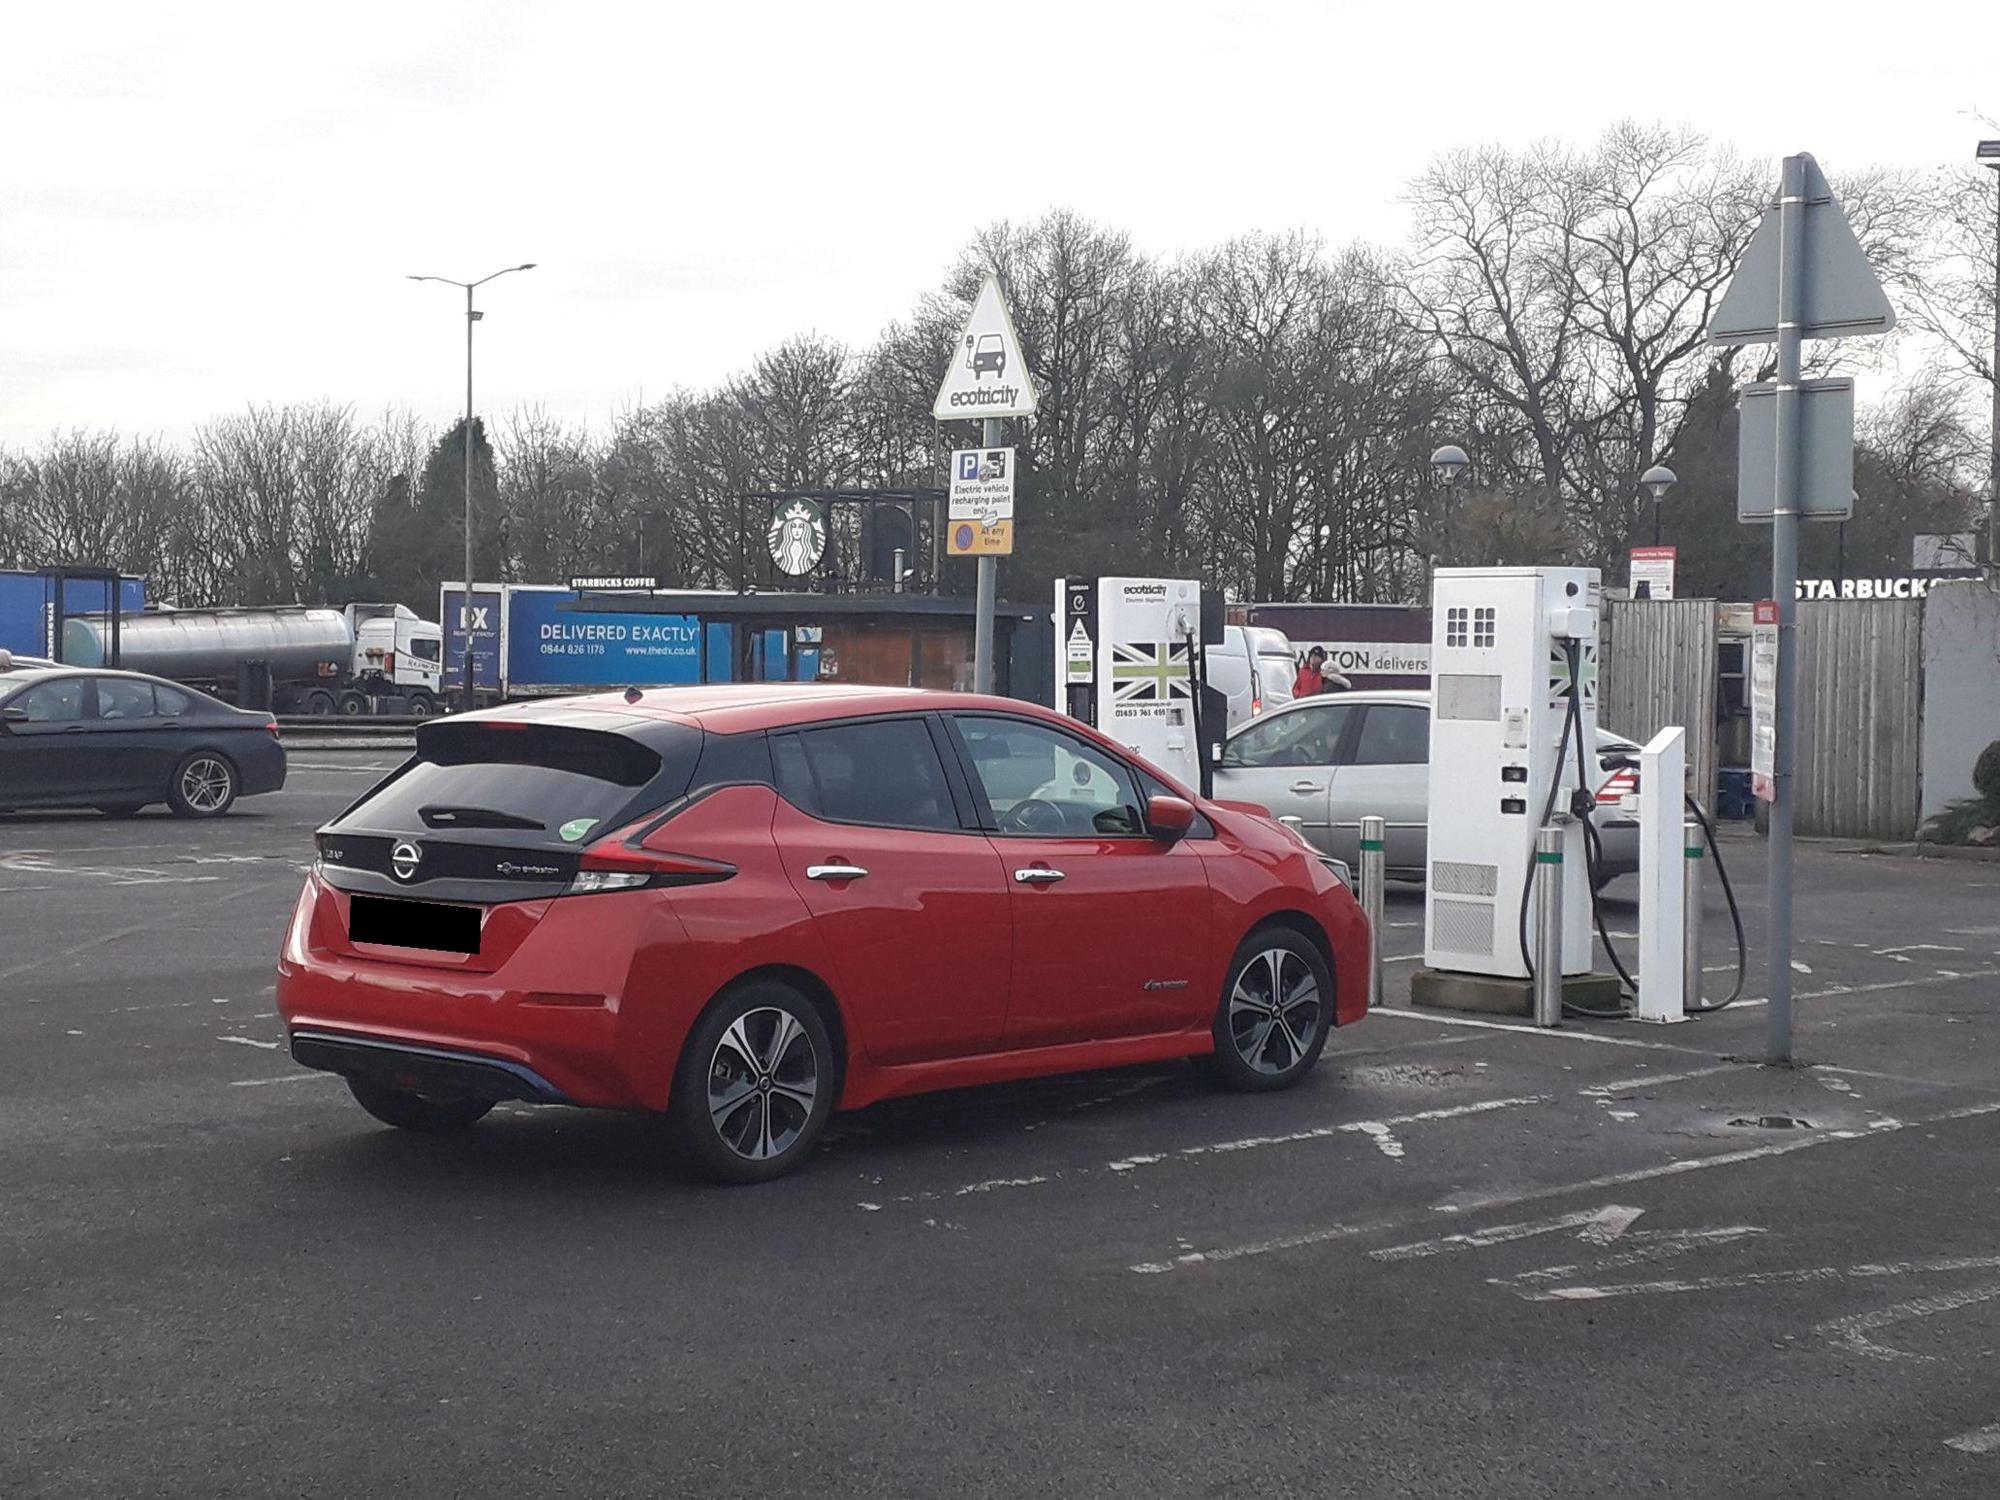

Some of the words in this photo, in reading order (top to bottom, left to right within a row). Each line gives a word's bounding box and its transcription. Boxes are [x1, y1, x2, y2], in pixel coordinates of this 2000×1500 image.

[950, 384, 1019, 408] ecotricity
[954, 485, 982, 495] Electric
[984, 484, 1009, 493] vehicle
[952, 497, 990, 506] recharging
[991, 496, 1010, 504] point
[973, 507, 988, 515] only
[992, 528, 1005, 536] any
[571, 577, 622, 588] STARBUCKS
[623, 577, 656, 588] COFFEE
[1796, 578, 1937, 599] STARBUCK
[1123, 584, 1167, 597] ecotricity
[540, 624, 627, 640] DELIVERED
[632, 626, 696, 641] EXACTLY
[540, 644, 565, 655] 0844
[567, 644, 585, 655] 826
[586, 644, 606, 655] 1178
[625, 645, 697, 656] www.thedx.co.uk
[1374, 655, 1429, 670] delivers
